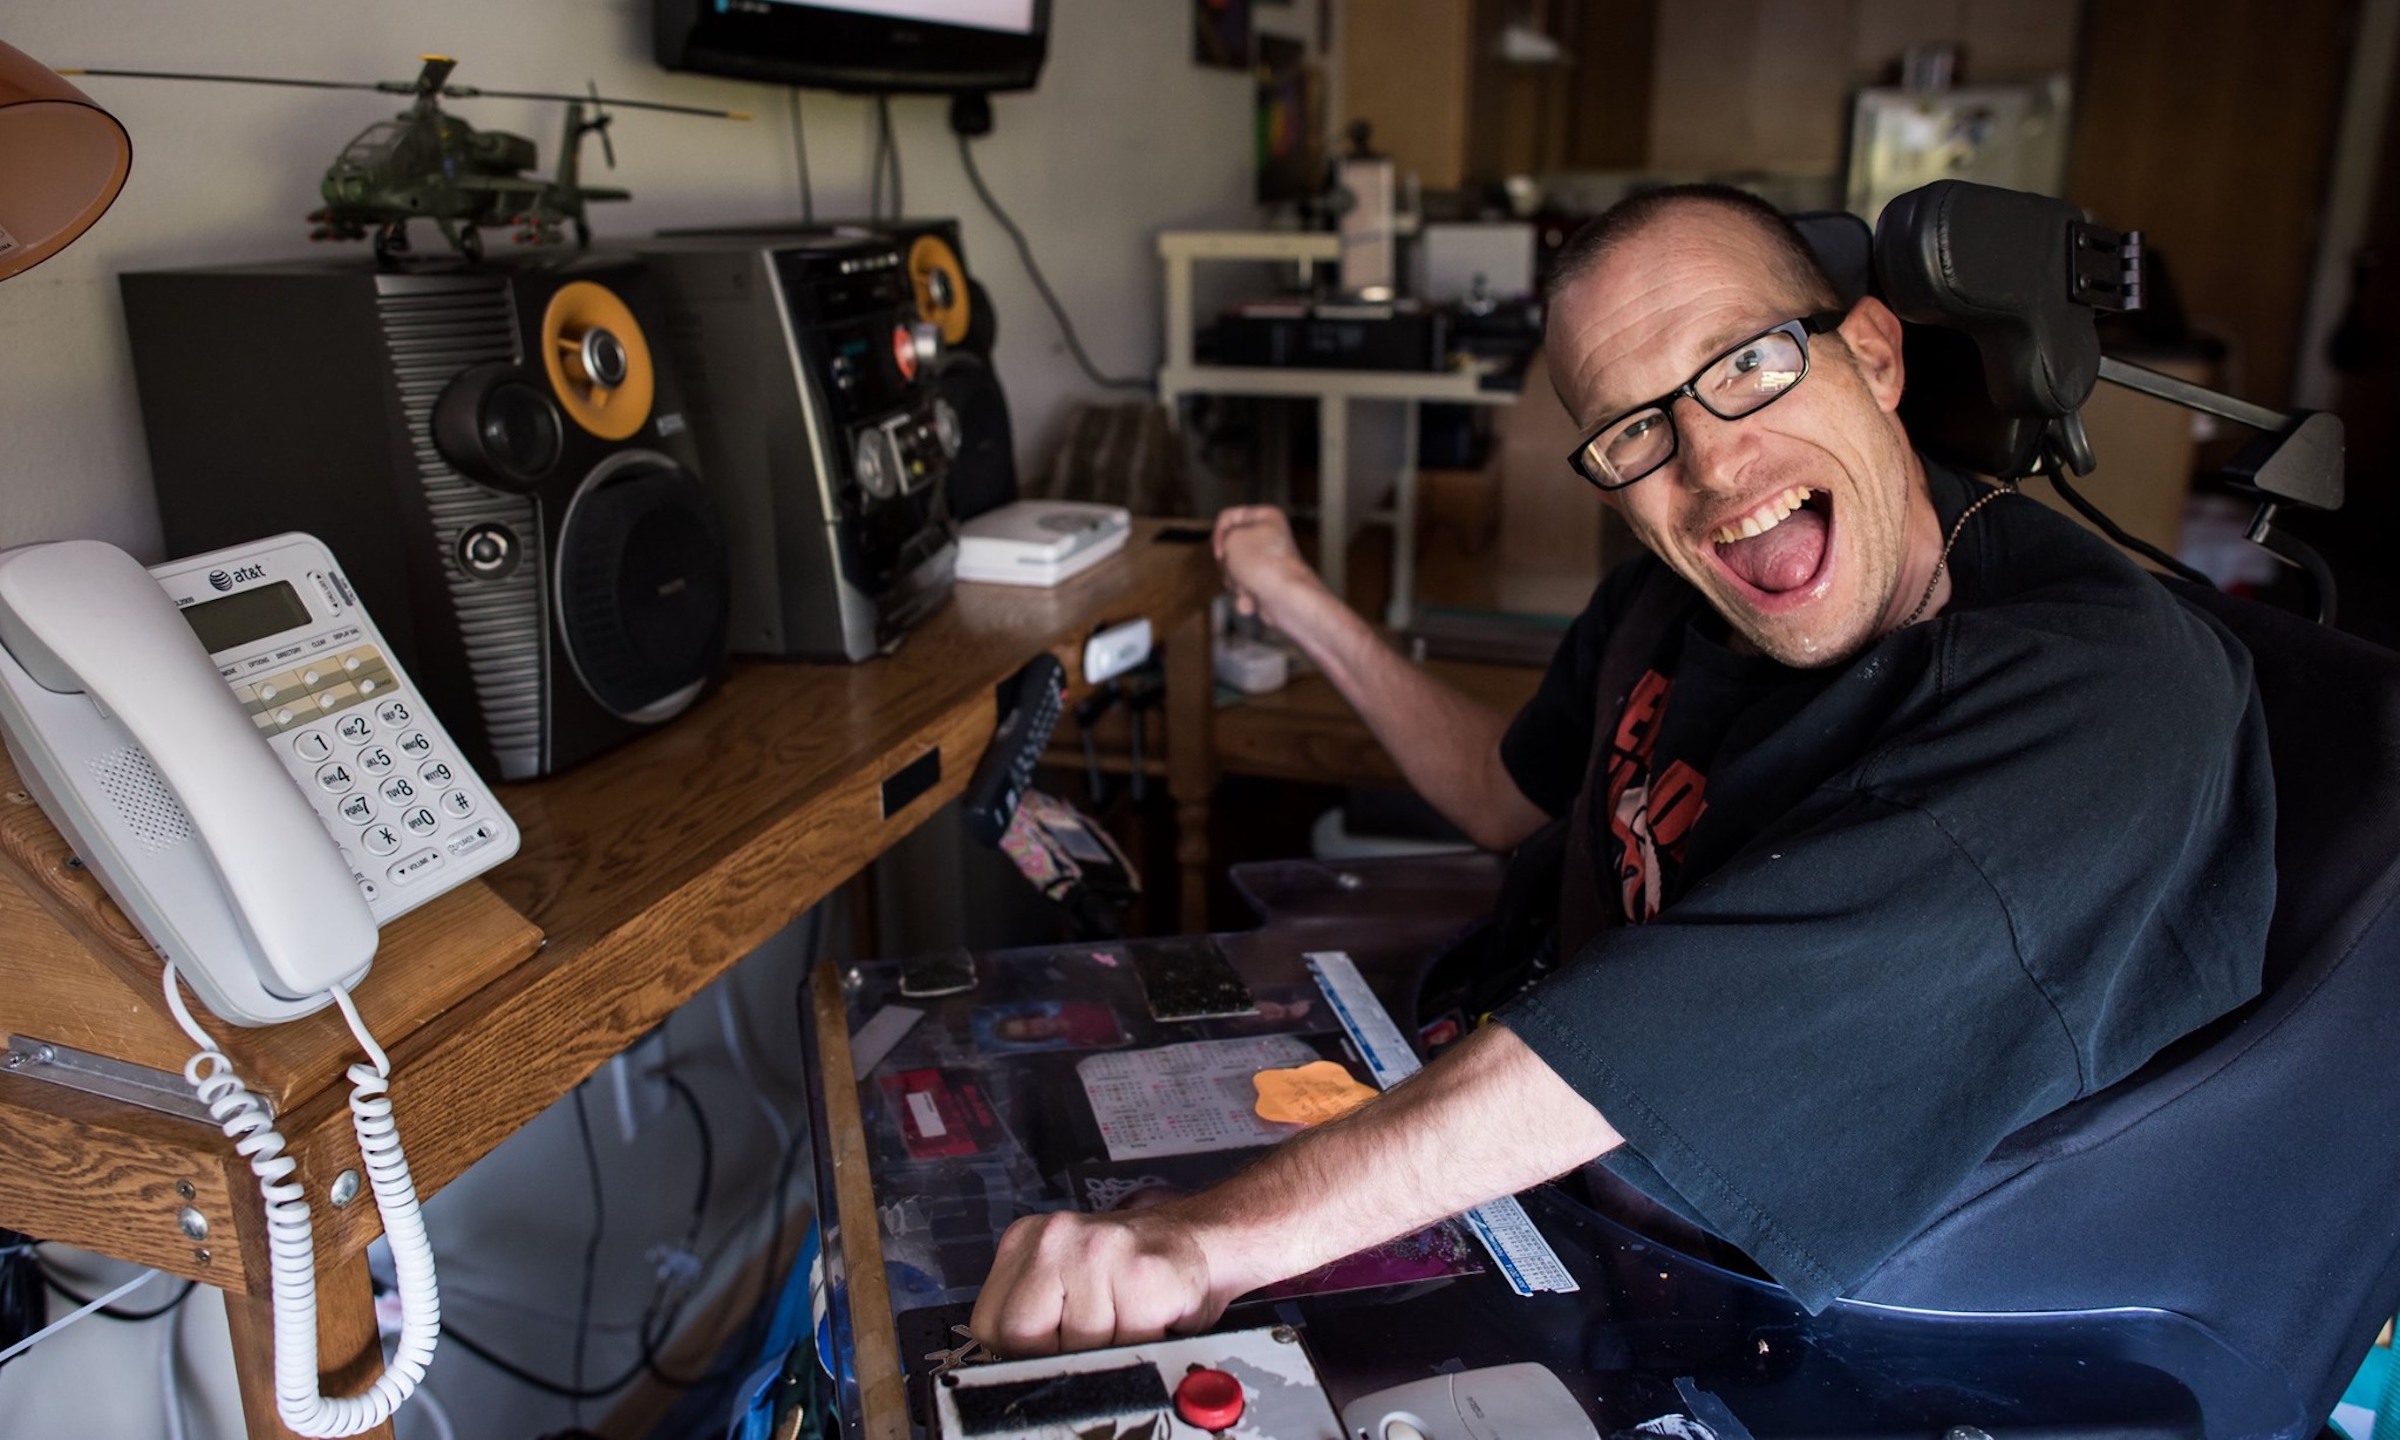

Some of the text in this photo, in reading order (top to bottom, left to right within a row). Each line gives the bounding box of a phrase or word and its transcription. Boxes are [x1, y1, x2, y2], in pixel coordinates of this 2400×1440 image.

[233, 563, 266, 583] at&t
[311, 639, 326, 648] CLEAR
[276, 647, 301, 659] DIRECTORY
[248, 657, 270, 668] OPTIONS
[222, 668, 237, 677] MOVE
[383, 704, 409, 721] DEF 3
[343, 718, 370, 737] ABC 2
[315, 734, 328, 750] 1
[415, 734, 428, 750] 6
[366, 749, 391, 768] JKL 5
[323, 766, 350, 785] GHI 4
[438, 764, 451, 779] 9
[386, 780, 413, 798] TUV 8
[345, 796, 370, 817] PQRS 7
[420, 809, 435, 826] 0
[409, 858, 429, 871] VOLUME
